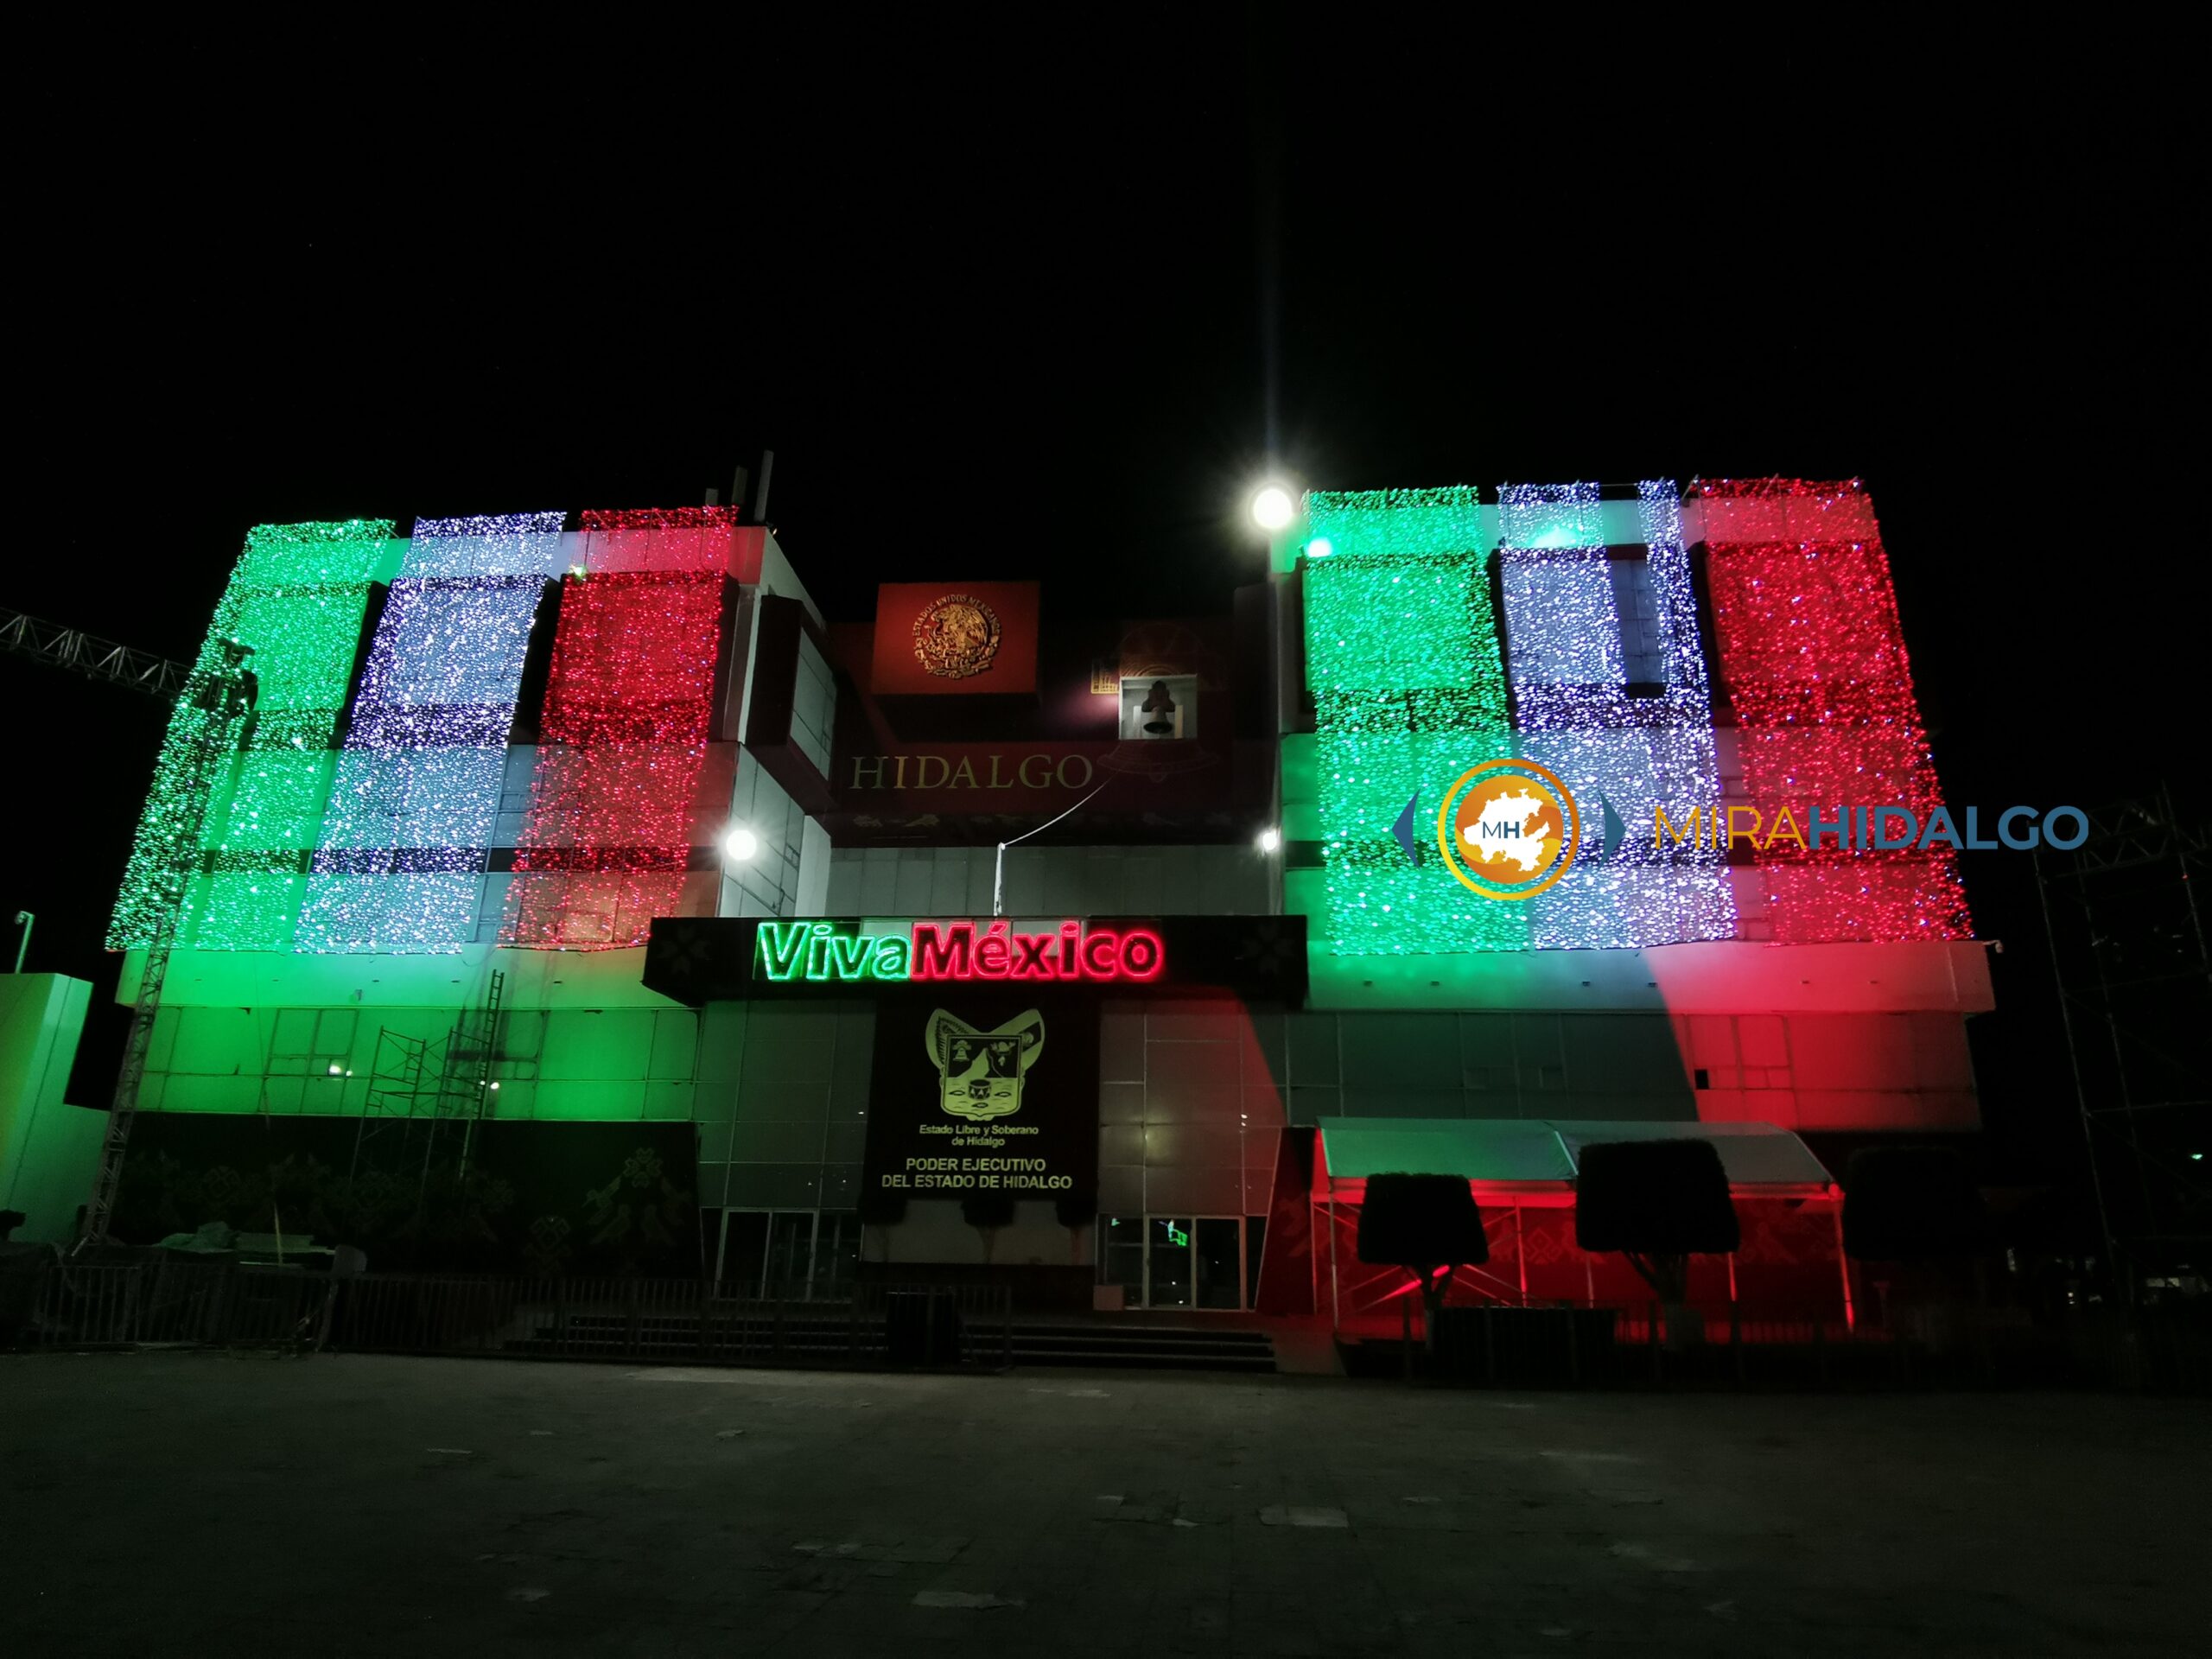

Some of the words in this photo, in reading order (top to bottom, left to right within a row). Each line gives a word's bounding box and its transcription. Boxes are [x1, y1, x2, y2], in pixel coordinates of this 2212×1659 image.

[936, 594, 968, 606] UNIDOS
[849, 754, 1093, 789] HIDALGO
[918, 1124, 953, 1135] Estado
[955, 1124, 981, 1135] Libre
[983, 1127, 990, 1138] y
[991, 1124, 1039, 1135] Soberano
[951, 1136, 965, 1147] de
[966, 1135, 1006, 1149] Hidalgo
[906, 1158, 958, 1172] PODER
[961, 1158, 1047, 1172] EJECUTIVO
[881, 1174, 912, 1188] DEL
[914, 1174, 976, 1188] ESTADO
[978, 1174, 1000, 1188] DE
[1003, 1175, 1073, 1189] HIDALGO
